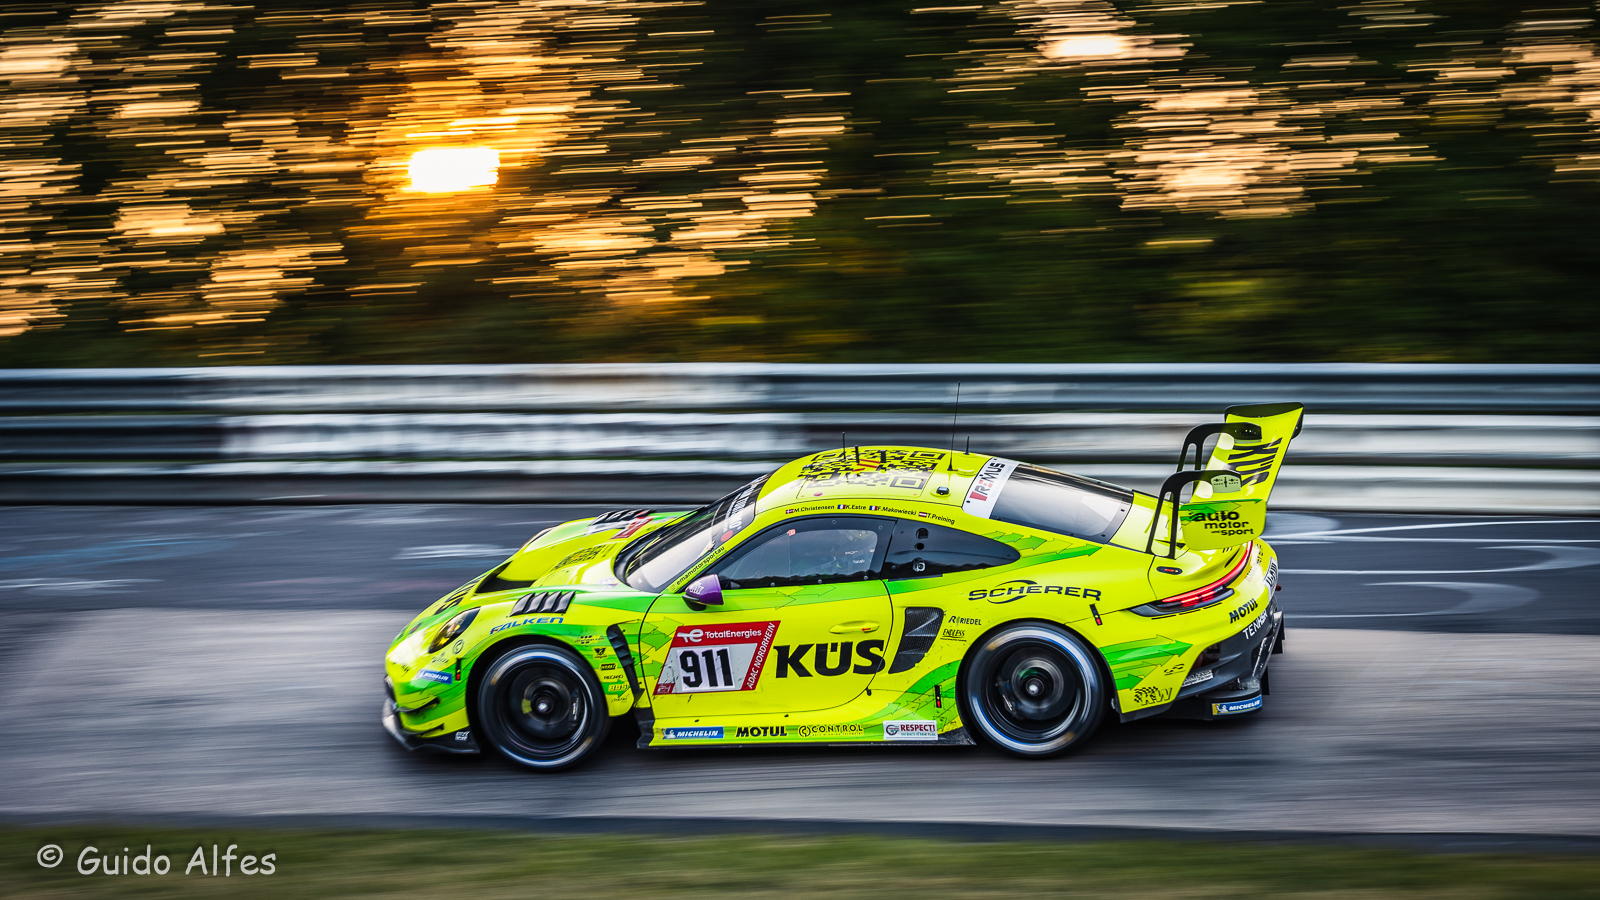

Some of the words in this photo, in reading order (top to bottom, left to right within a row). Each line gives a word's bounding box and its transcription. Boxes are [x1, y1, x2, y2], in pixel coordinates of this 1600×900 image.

[974, 462, 1006, 495] REMUS
[793, 504, 835, 513] M.Christensen
[877, 506, 917, 516] F.Makowiecki
[926, 513, 956, 525] T.Preining
[1195, 511, 1240, 521] auto
[1204, 521, 1249, 529] motor
[1221, 528, 1254, 536] sport
[968, 585, 1102, 601] SCHERER
[1229, 598, 1258, 624] MOTUL
[489, 617, 564, 635] FALKEN
[959, 617, 982, 625] RIEDEL
[705, 629, 762, 639] TotalEnergies
[942, 628, 965, 637] ENDLESS
[746, 668, 759, 689] ADAC
[754, 622, 776, 669] NORDRHEIN
[773, 639, 886, 679] KÜS
[679, 648, 734, 688] 911
[1229, 699, 1260, 711] MICHELIN
[736, 726, 787, 737] MOTUL
[812, 724, 863, 733] CONTROL
[900, 724, 936, 732] RESPECT!
[676, 730, 719, 738] MICHELIN
